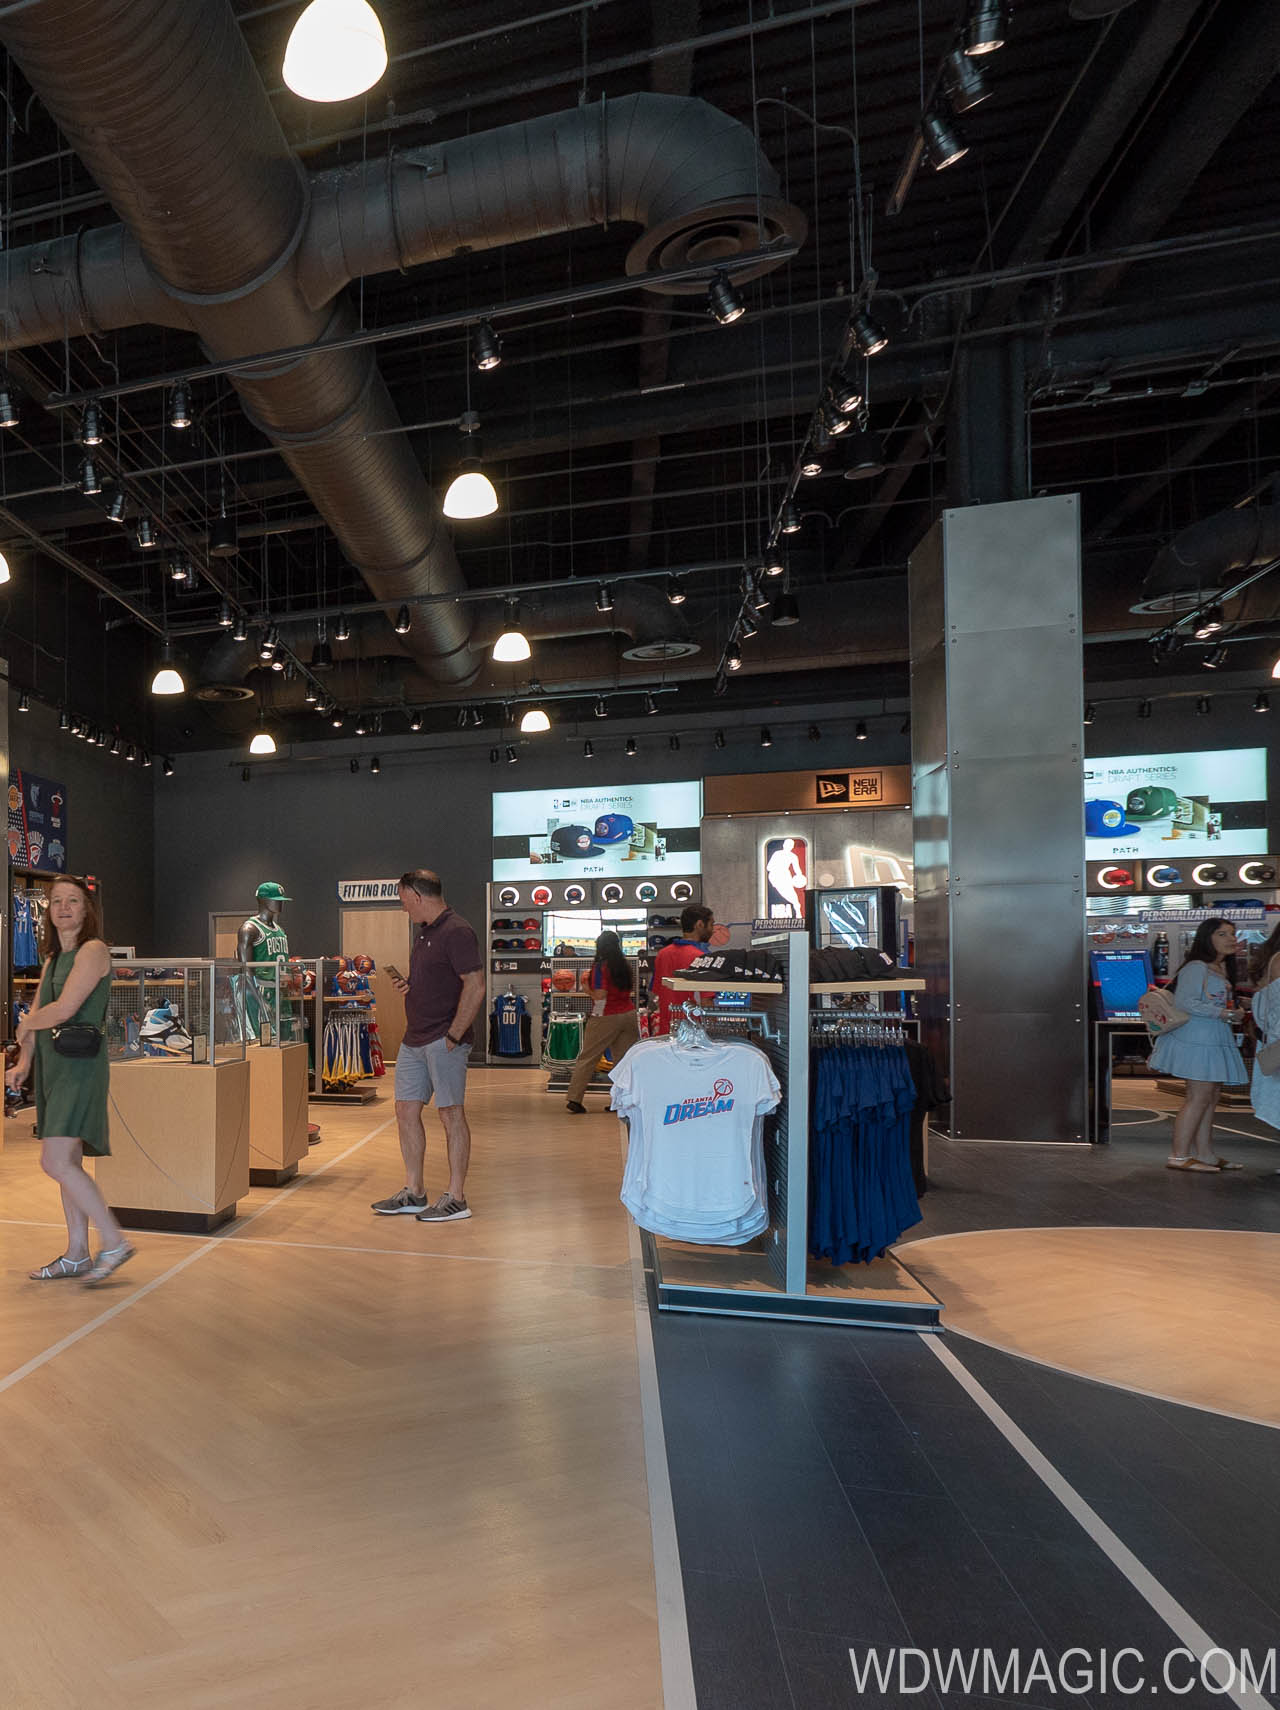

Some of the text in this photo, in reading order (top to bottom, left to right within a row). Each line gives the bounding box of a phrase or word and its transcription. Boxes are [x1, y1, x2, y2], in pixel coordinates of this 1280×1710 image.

[853, 778, 878, 788] NEW
[853, 786, 878, 796] ERA
[343, 883, 400, 898] FITTING ROO
[771, 904, 793, 919] NBA
[1141, 908, 1263, 922] PERSONALIZATION STATION
[754, 918, 805, 930] PERSONALIZAT
[503, 1012, 516, 1024] 00
[683, 1096, 713, 1105] ATLANTA
[663, 1098, 735, 1125] DREAM
